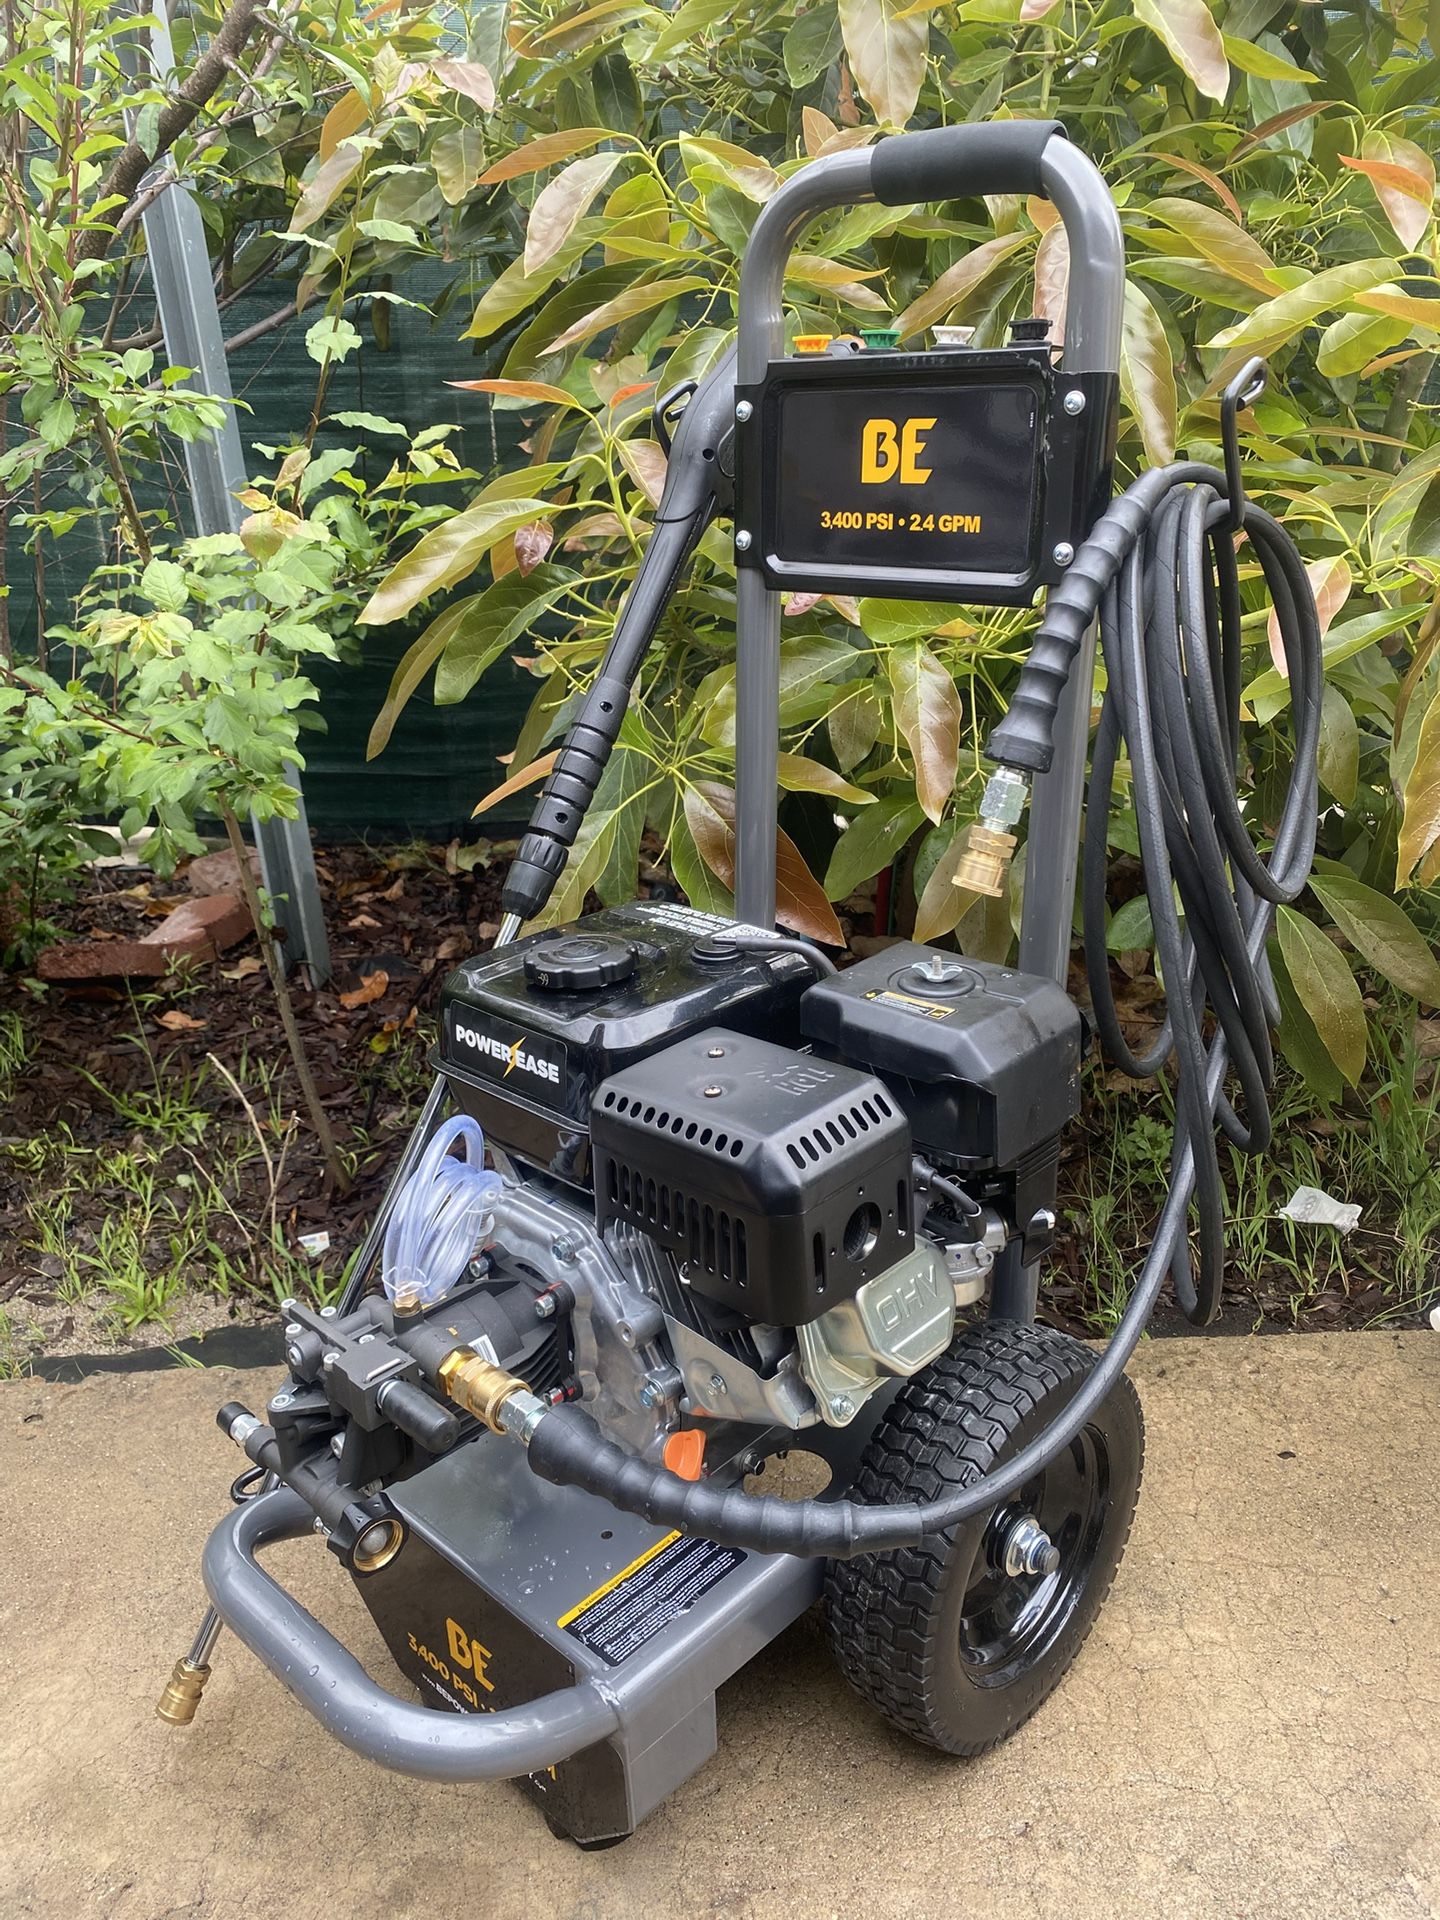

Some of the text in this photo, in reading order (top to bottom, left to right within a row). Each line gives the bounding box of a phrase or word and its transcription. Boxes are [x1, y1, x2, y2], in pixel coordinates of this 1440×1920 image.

[861, 417, 937, 484] BE
[821, 511, 981, 533] 3,400 PSI 2.4 GPM
[455, 1024, 560, 1084] POWER EASE
[876, 1264, 938, 1332] OHV
[408, 1631, 479, 1708] 3,400 PSI
[446, 1617, 495, 1692] BE
